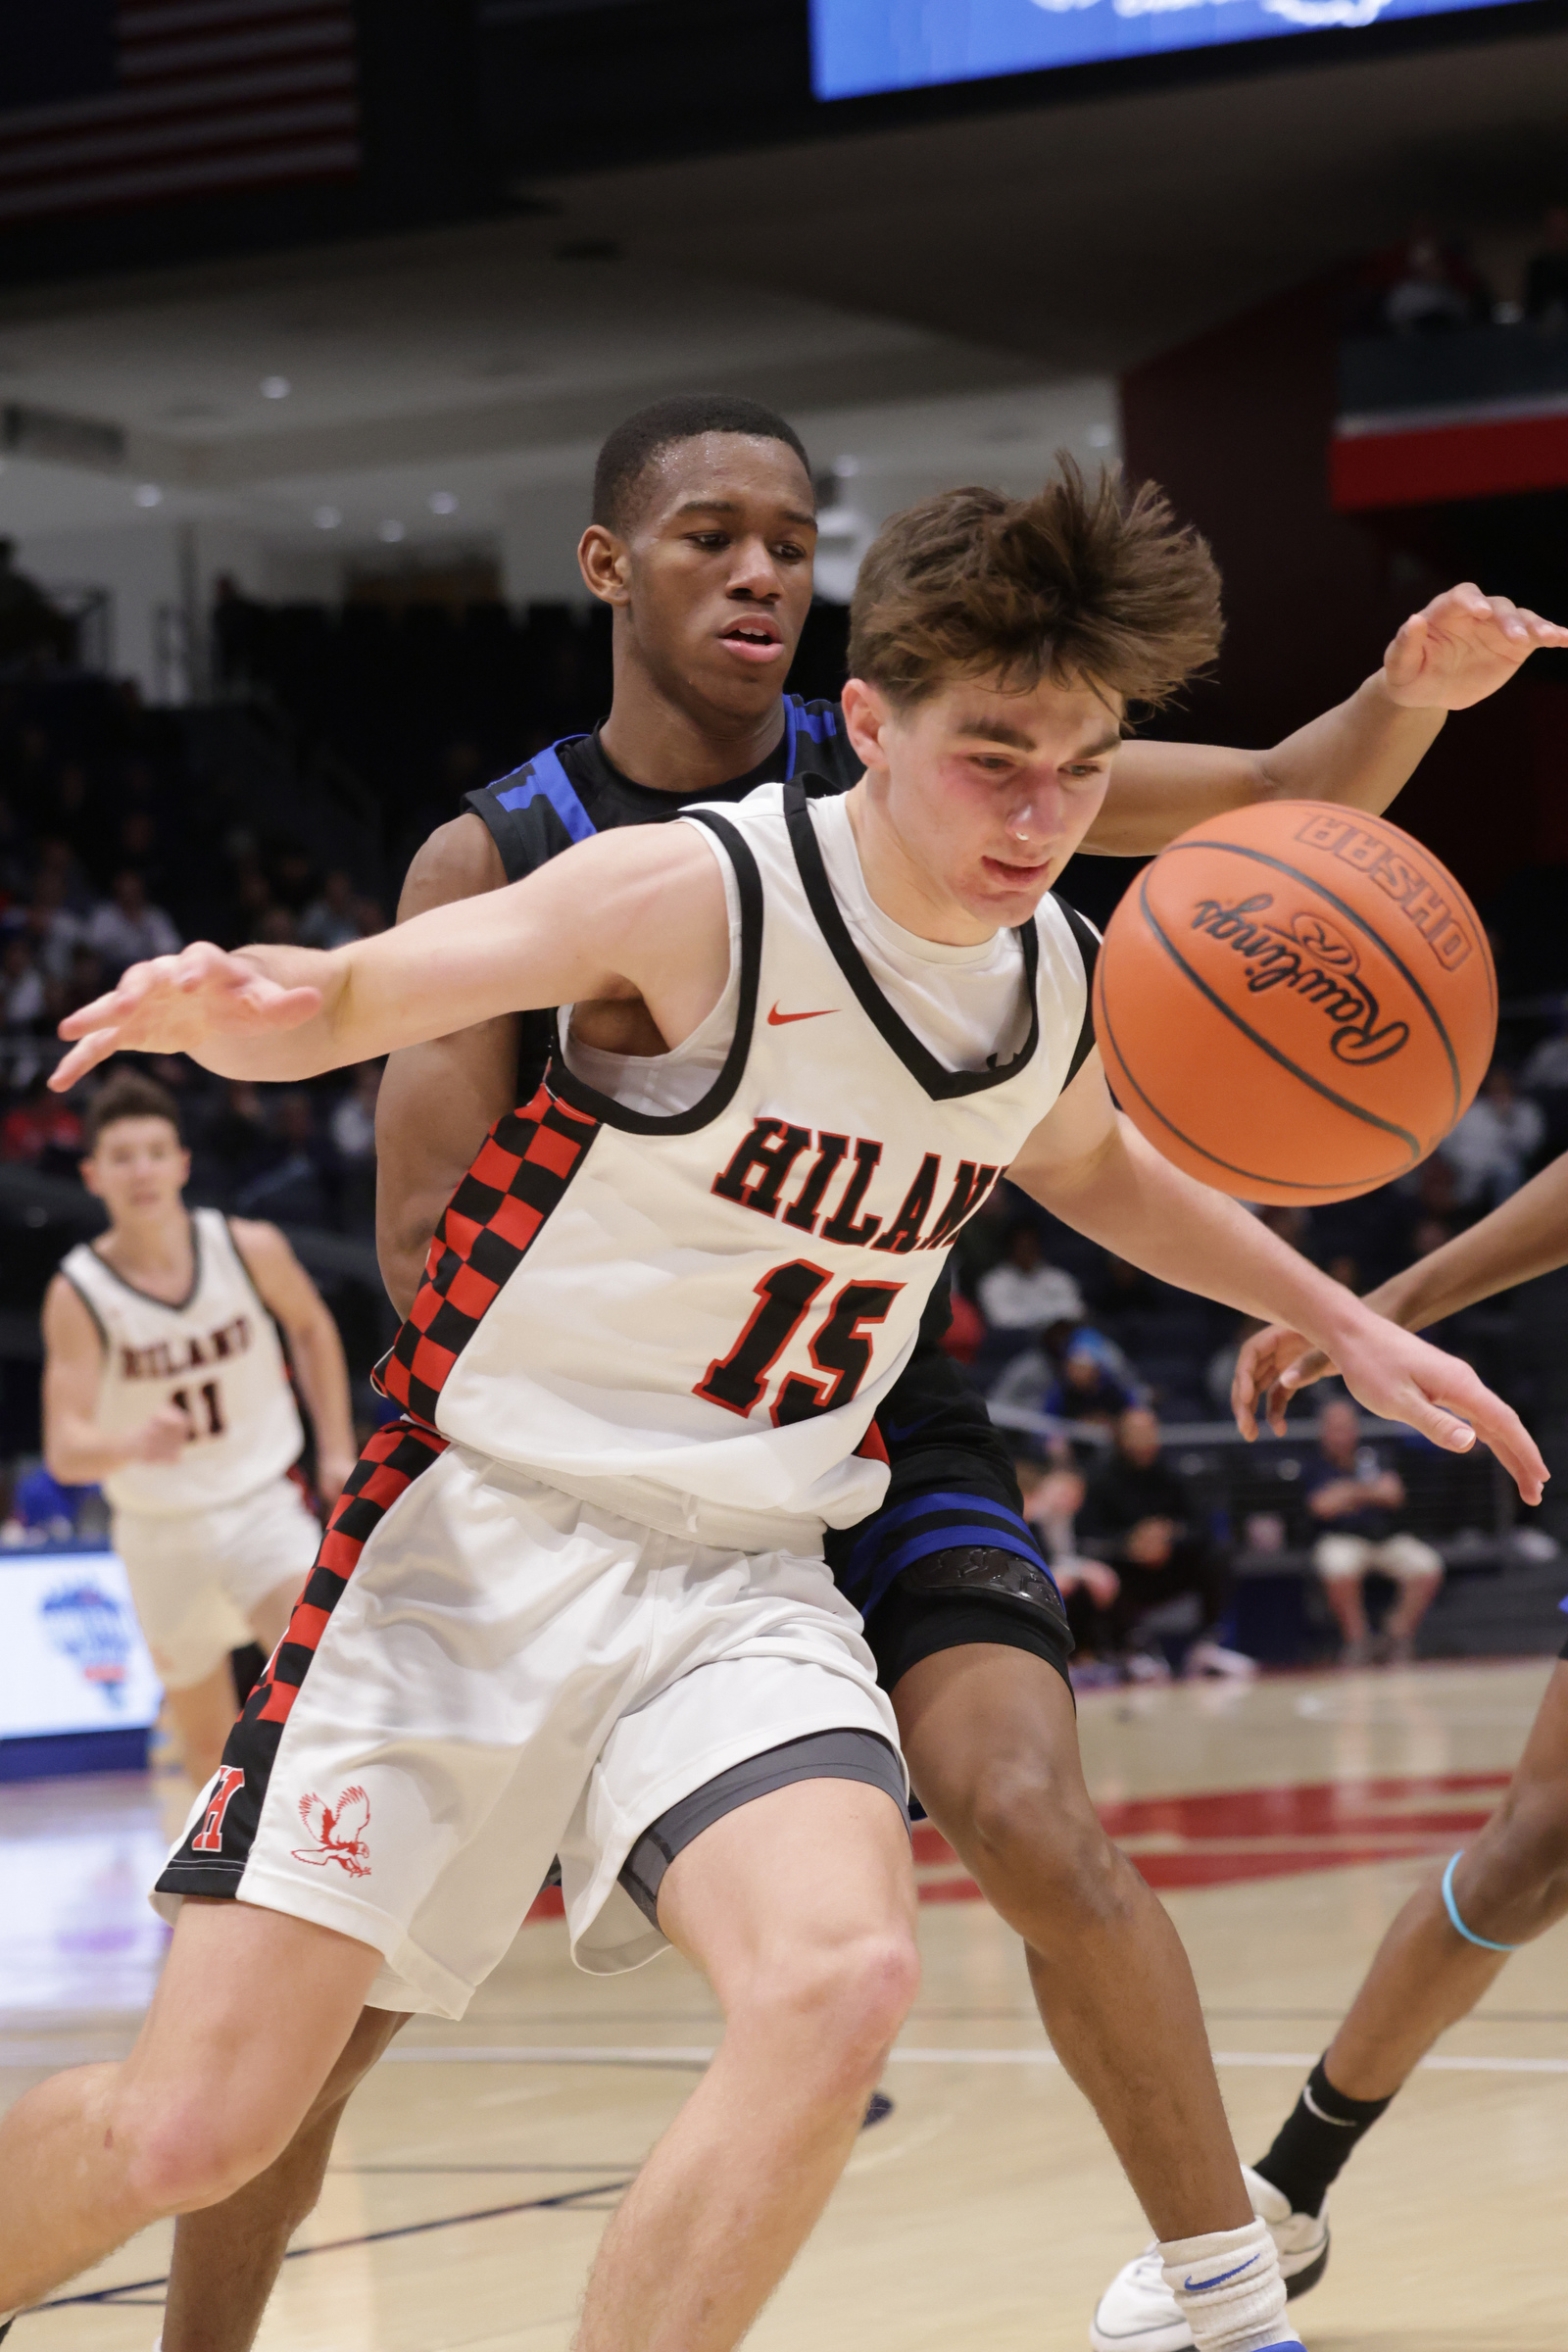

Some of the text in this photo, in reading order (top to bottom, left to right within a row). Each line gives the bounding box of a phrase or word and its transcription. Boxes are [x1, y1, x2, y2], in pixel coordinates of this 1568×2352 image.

[1294, 812, 1471, 972] OHSAA
[1190, 893, 1409, 1065] Rawlings
[710, 1117, 1010, 1254] HILAN
[691, 1258, 908, 1428] 15
